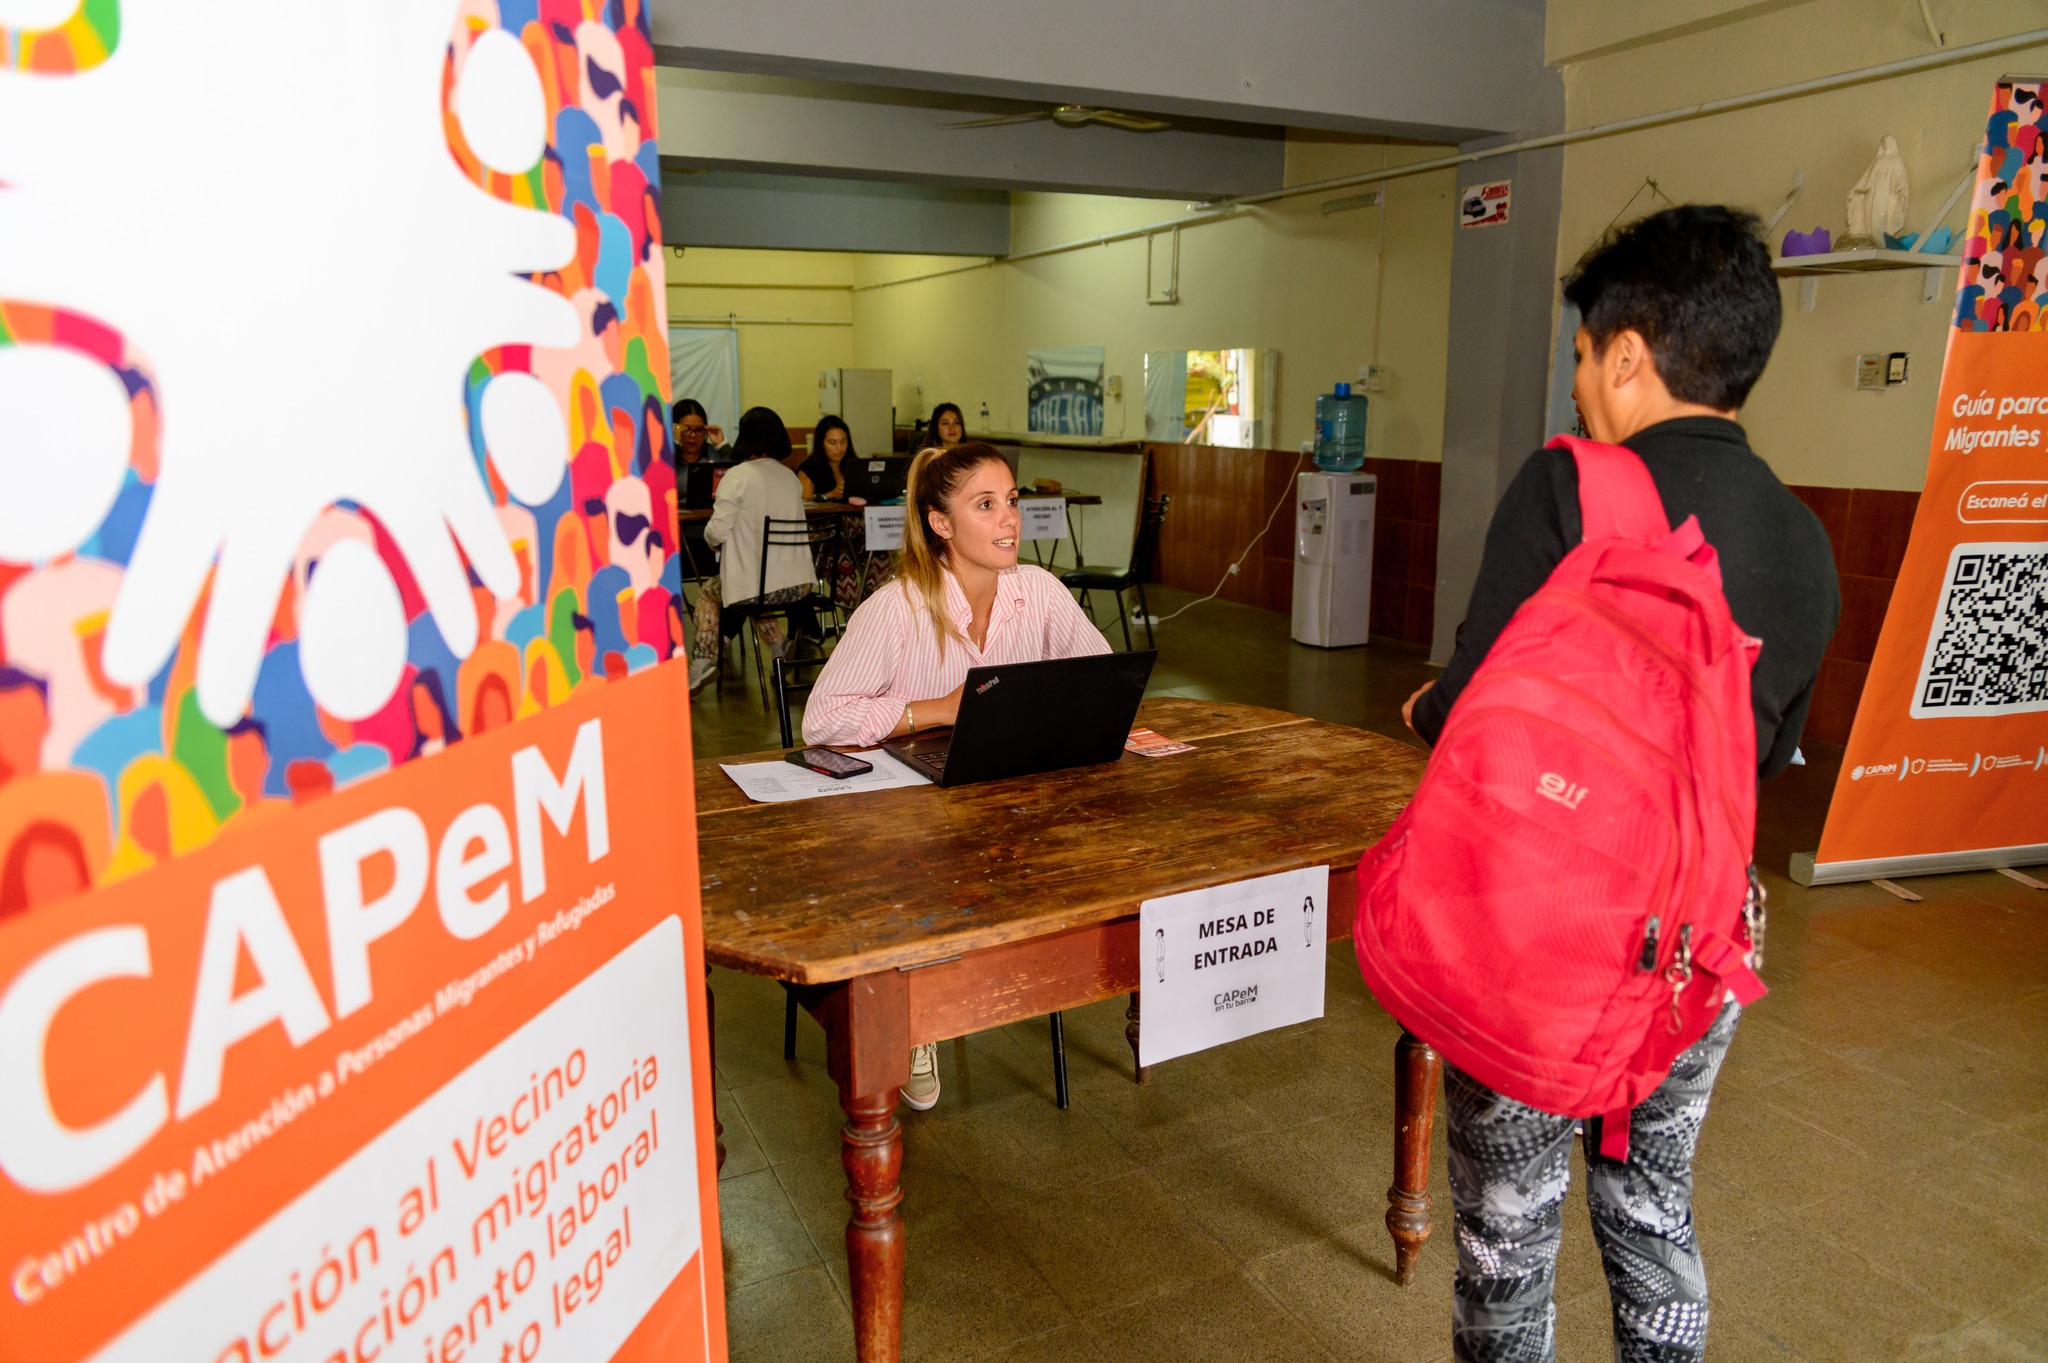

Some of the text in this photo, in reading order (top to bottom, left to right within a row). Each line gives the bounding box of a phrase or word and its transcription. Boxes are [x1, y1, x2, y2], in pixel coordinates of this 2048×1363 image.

[1953, 390, 1995, 417] Guía
[1944, 425, 2040, 454] Migrantes
[1966, 492, 2048, 509] Escaneá el
[1198, 908, 1275, 939] MESA DE
[0, 717, 610, 1194] CAPeM
[1194, 937, 1278, 970] ENTRADA
[1213, 984, 1258, 1005] CAPeM
[1215, 1004, 1225, 1012] en
[1226, 1001, 1234, 1009] tu
[12, 882, 615, 1304] Centro de Atención a Personas Migrantes y Refugiadas
[397, 1157, 439, 1238] al
[452, 1047, 587, 1180] Vecino
[472, 1055, 659, 1258] migratoria
[546, 1107, 658, 1260] laboral
[552, 1204, 631, 1329] legal
